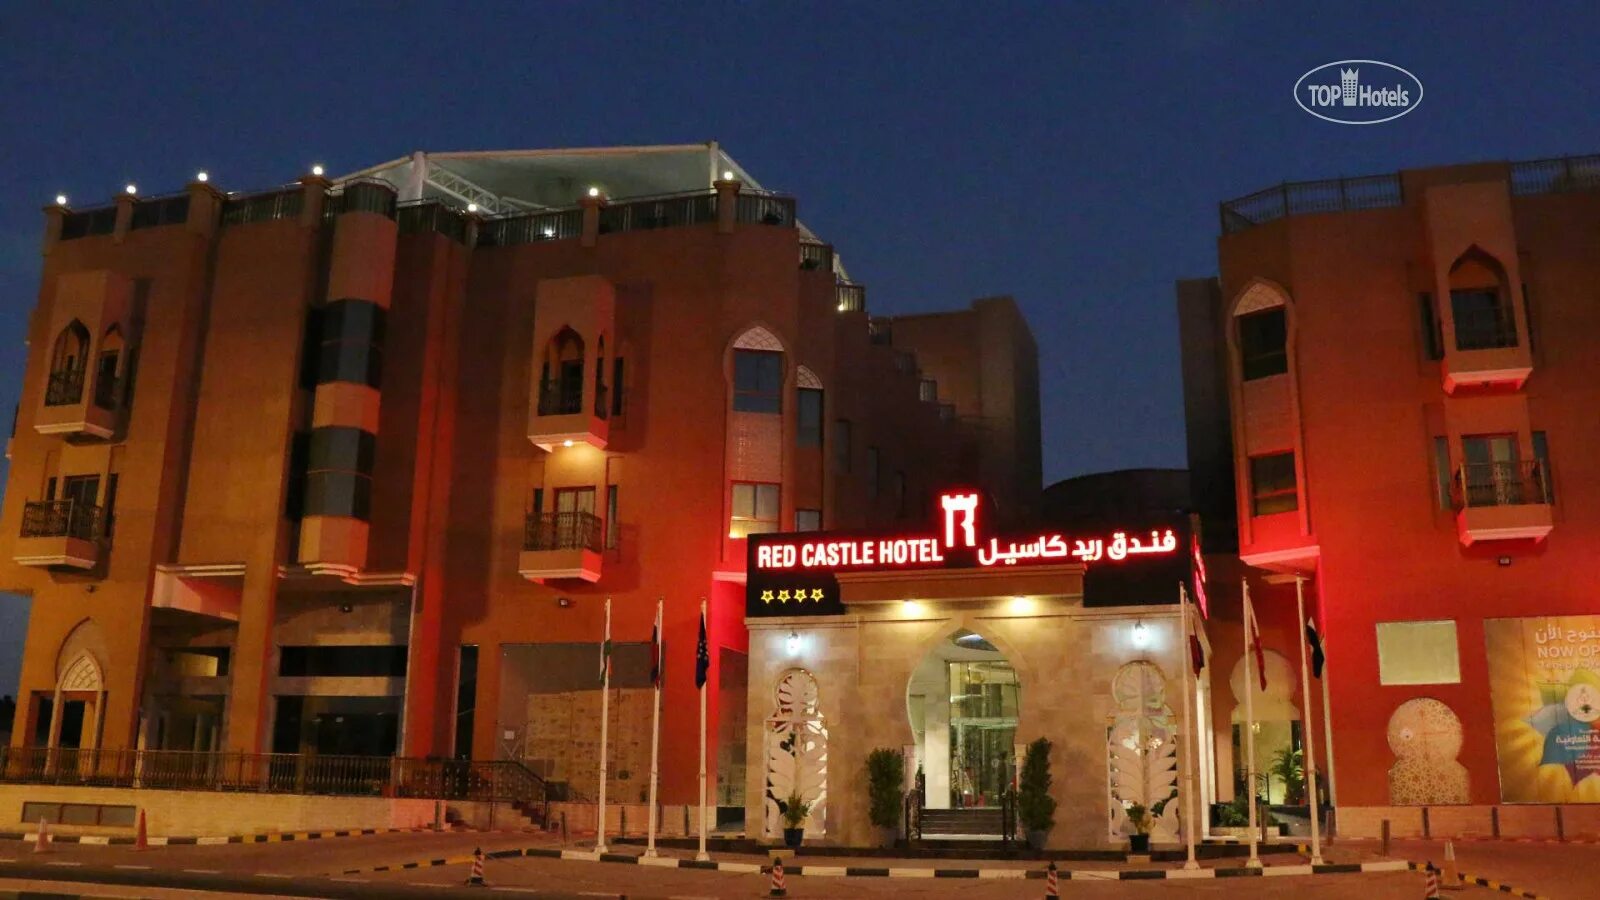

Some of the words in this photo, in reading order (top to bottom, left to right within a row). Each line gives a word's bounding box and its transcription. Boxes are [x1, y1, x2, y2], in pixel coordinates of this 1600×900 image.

[757, 544, 797, 568] RED
[801, 541, 875, 567] CASTLE
[879, 538, 944, 564] HOTEL
[977, 534, 1068, 566] كاسيل
[1071, 538, 1104, 562] ريد
[1106, 529, 1177, 561] فندق
[1537, 646, 1573, 658] NOW
